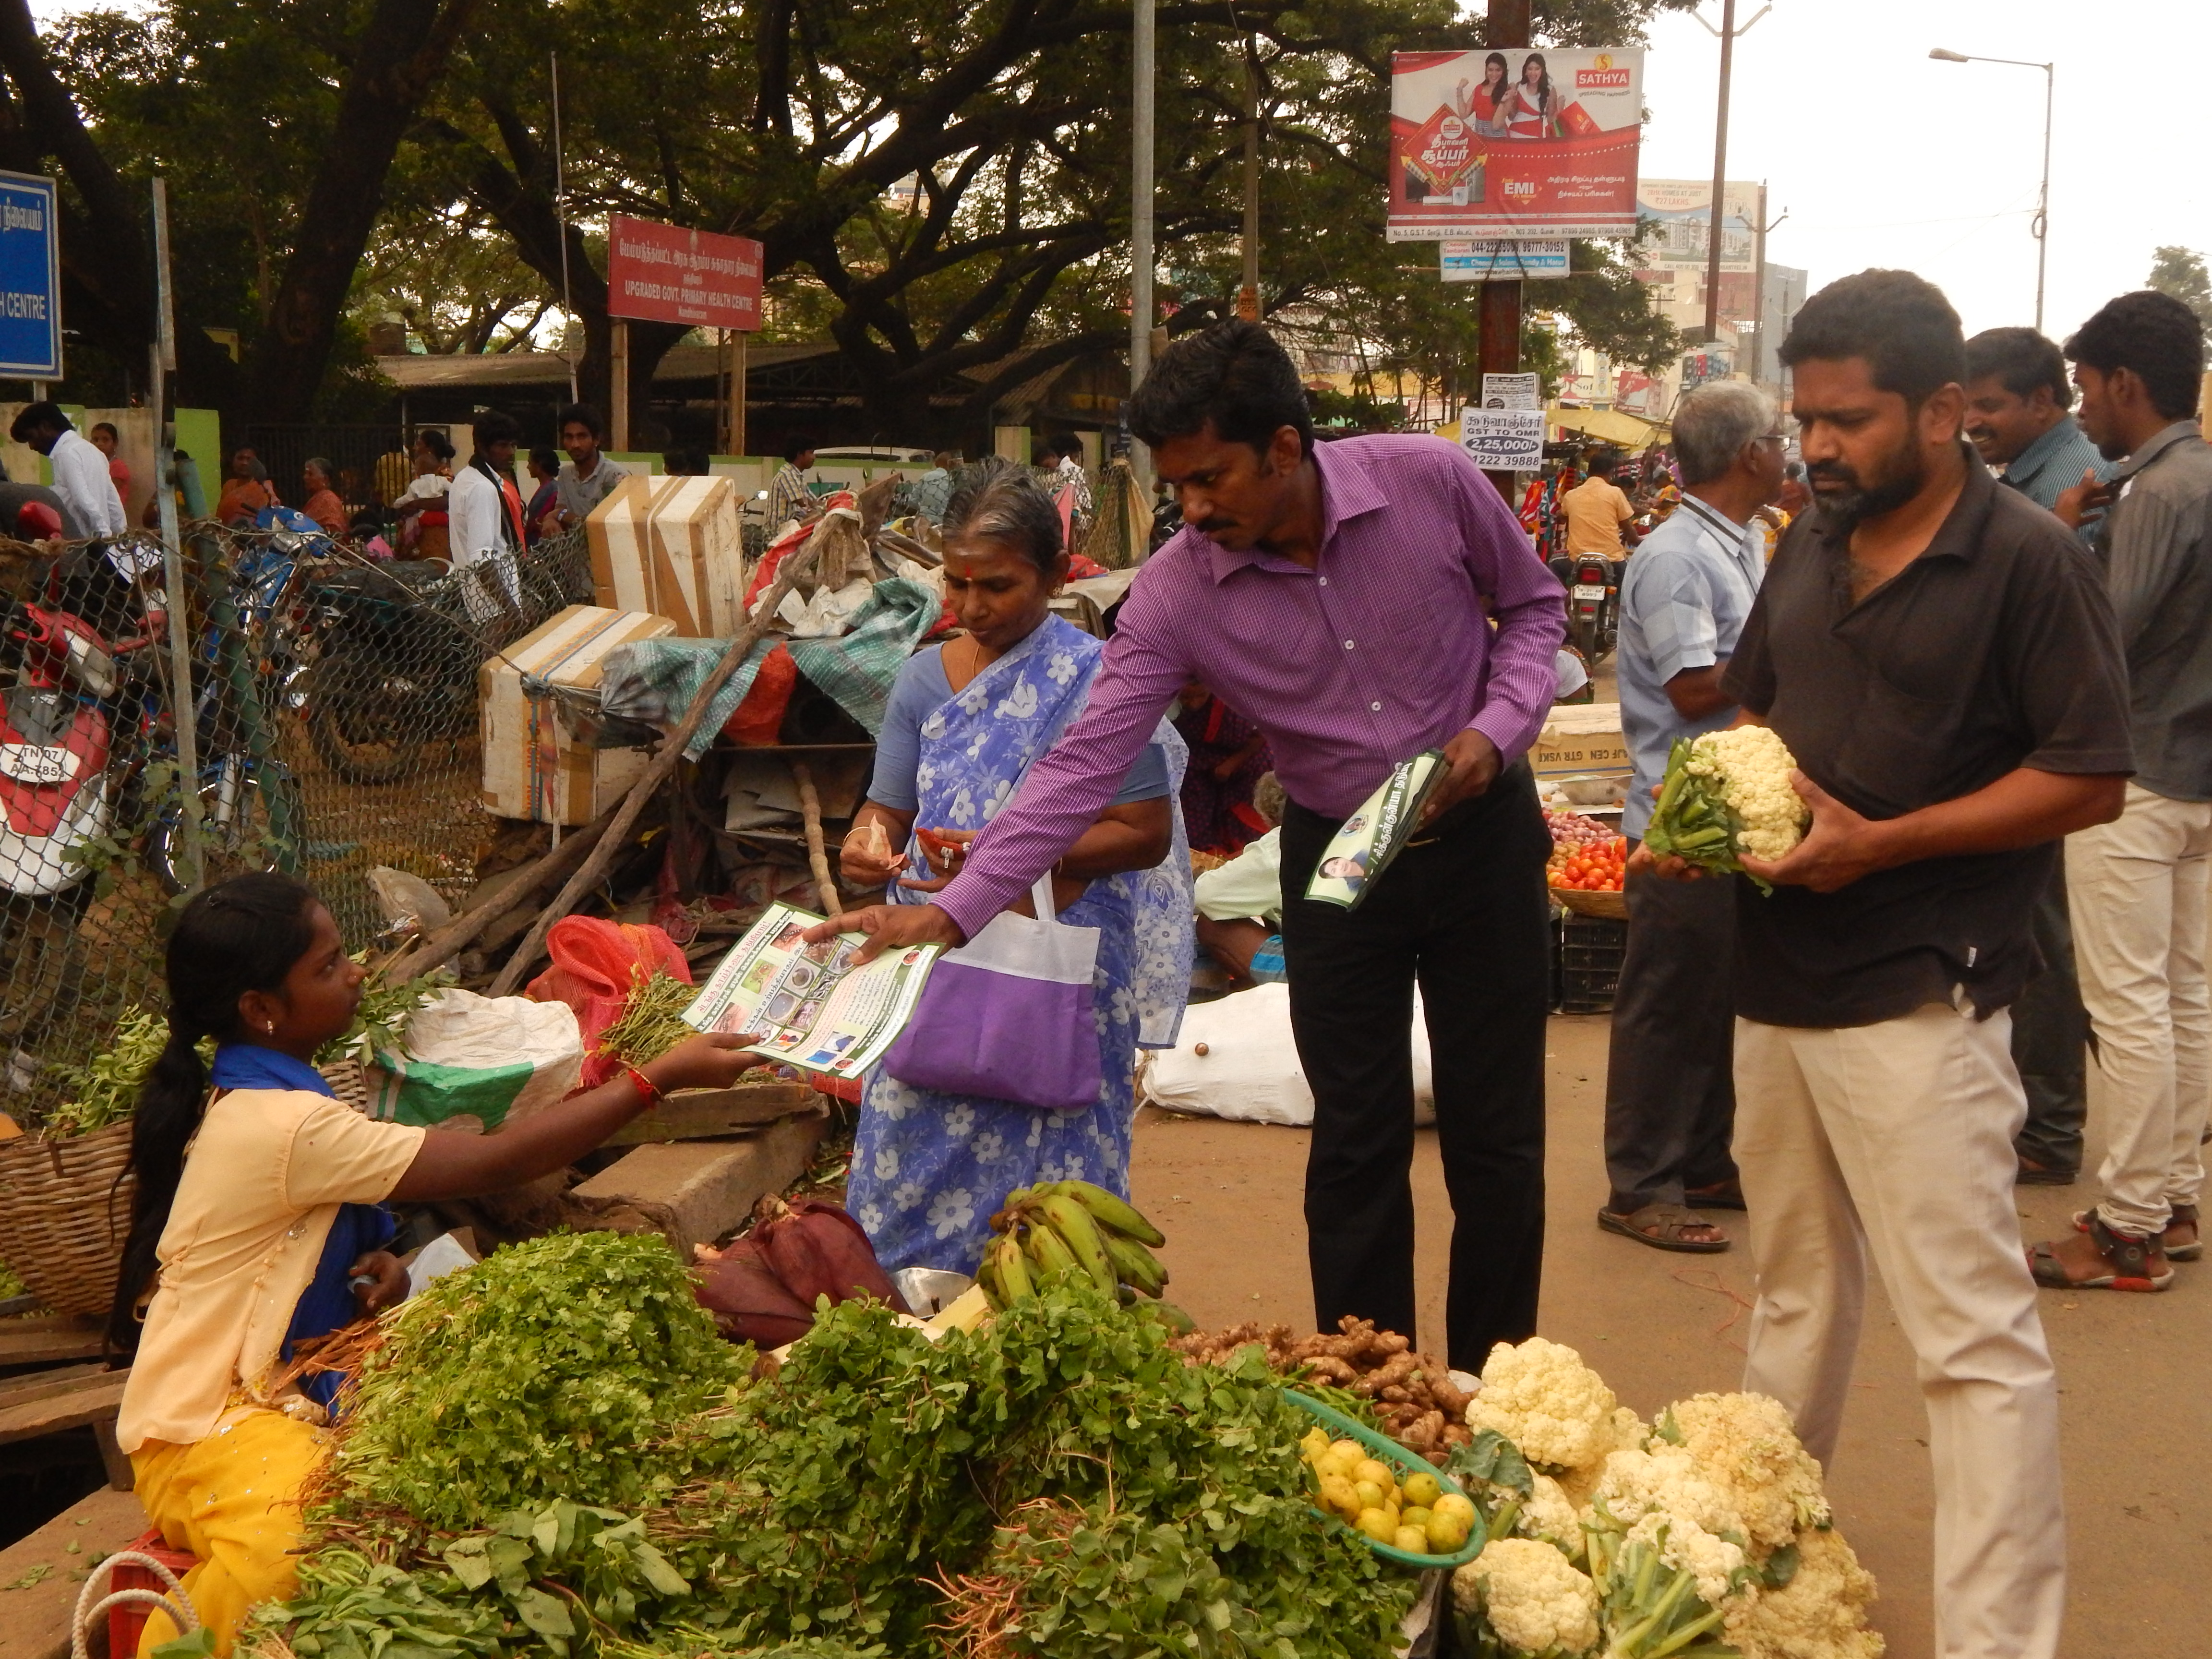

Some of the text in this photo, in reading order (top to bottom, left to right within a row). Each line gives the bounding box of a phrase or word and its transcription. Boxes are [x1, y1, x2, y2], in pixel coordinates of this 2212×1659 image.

[1578, 73, 1627, 84] SATHYA
[1431, 133, 1469, 149] தீபாவளி
[1421, 145, 1469, 164] சூப்பர்
[1504, 182, 1534, 194] EMI
[3, 196, 43, 233] நிலையம்
[625, 280, 753, 312] UPGRADED GOVT. PRIMARY HEALTH CENTRE
[7, 292, 46, 320] CENTRE
[1467, 414, 1542, 429] கூடுவாஞ்சேரி
[1471, 439, 1536, 451] 2,25,000/-
[1472, 455, 1539, 466] 1222 39888
[24, 748, 39, 757] TN
[1563, 750, 1583, 761] GTR
[1590, 750, 1610, 760] CEN
[696, 987, 720, 1013] டெங்கு
